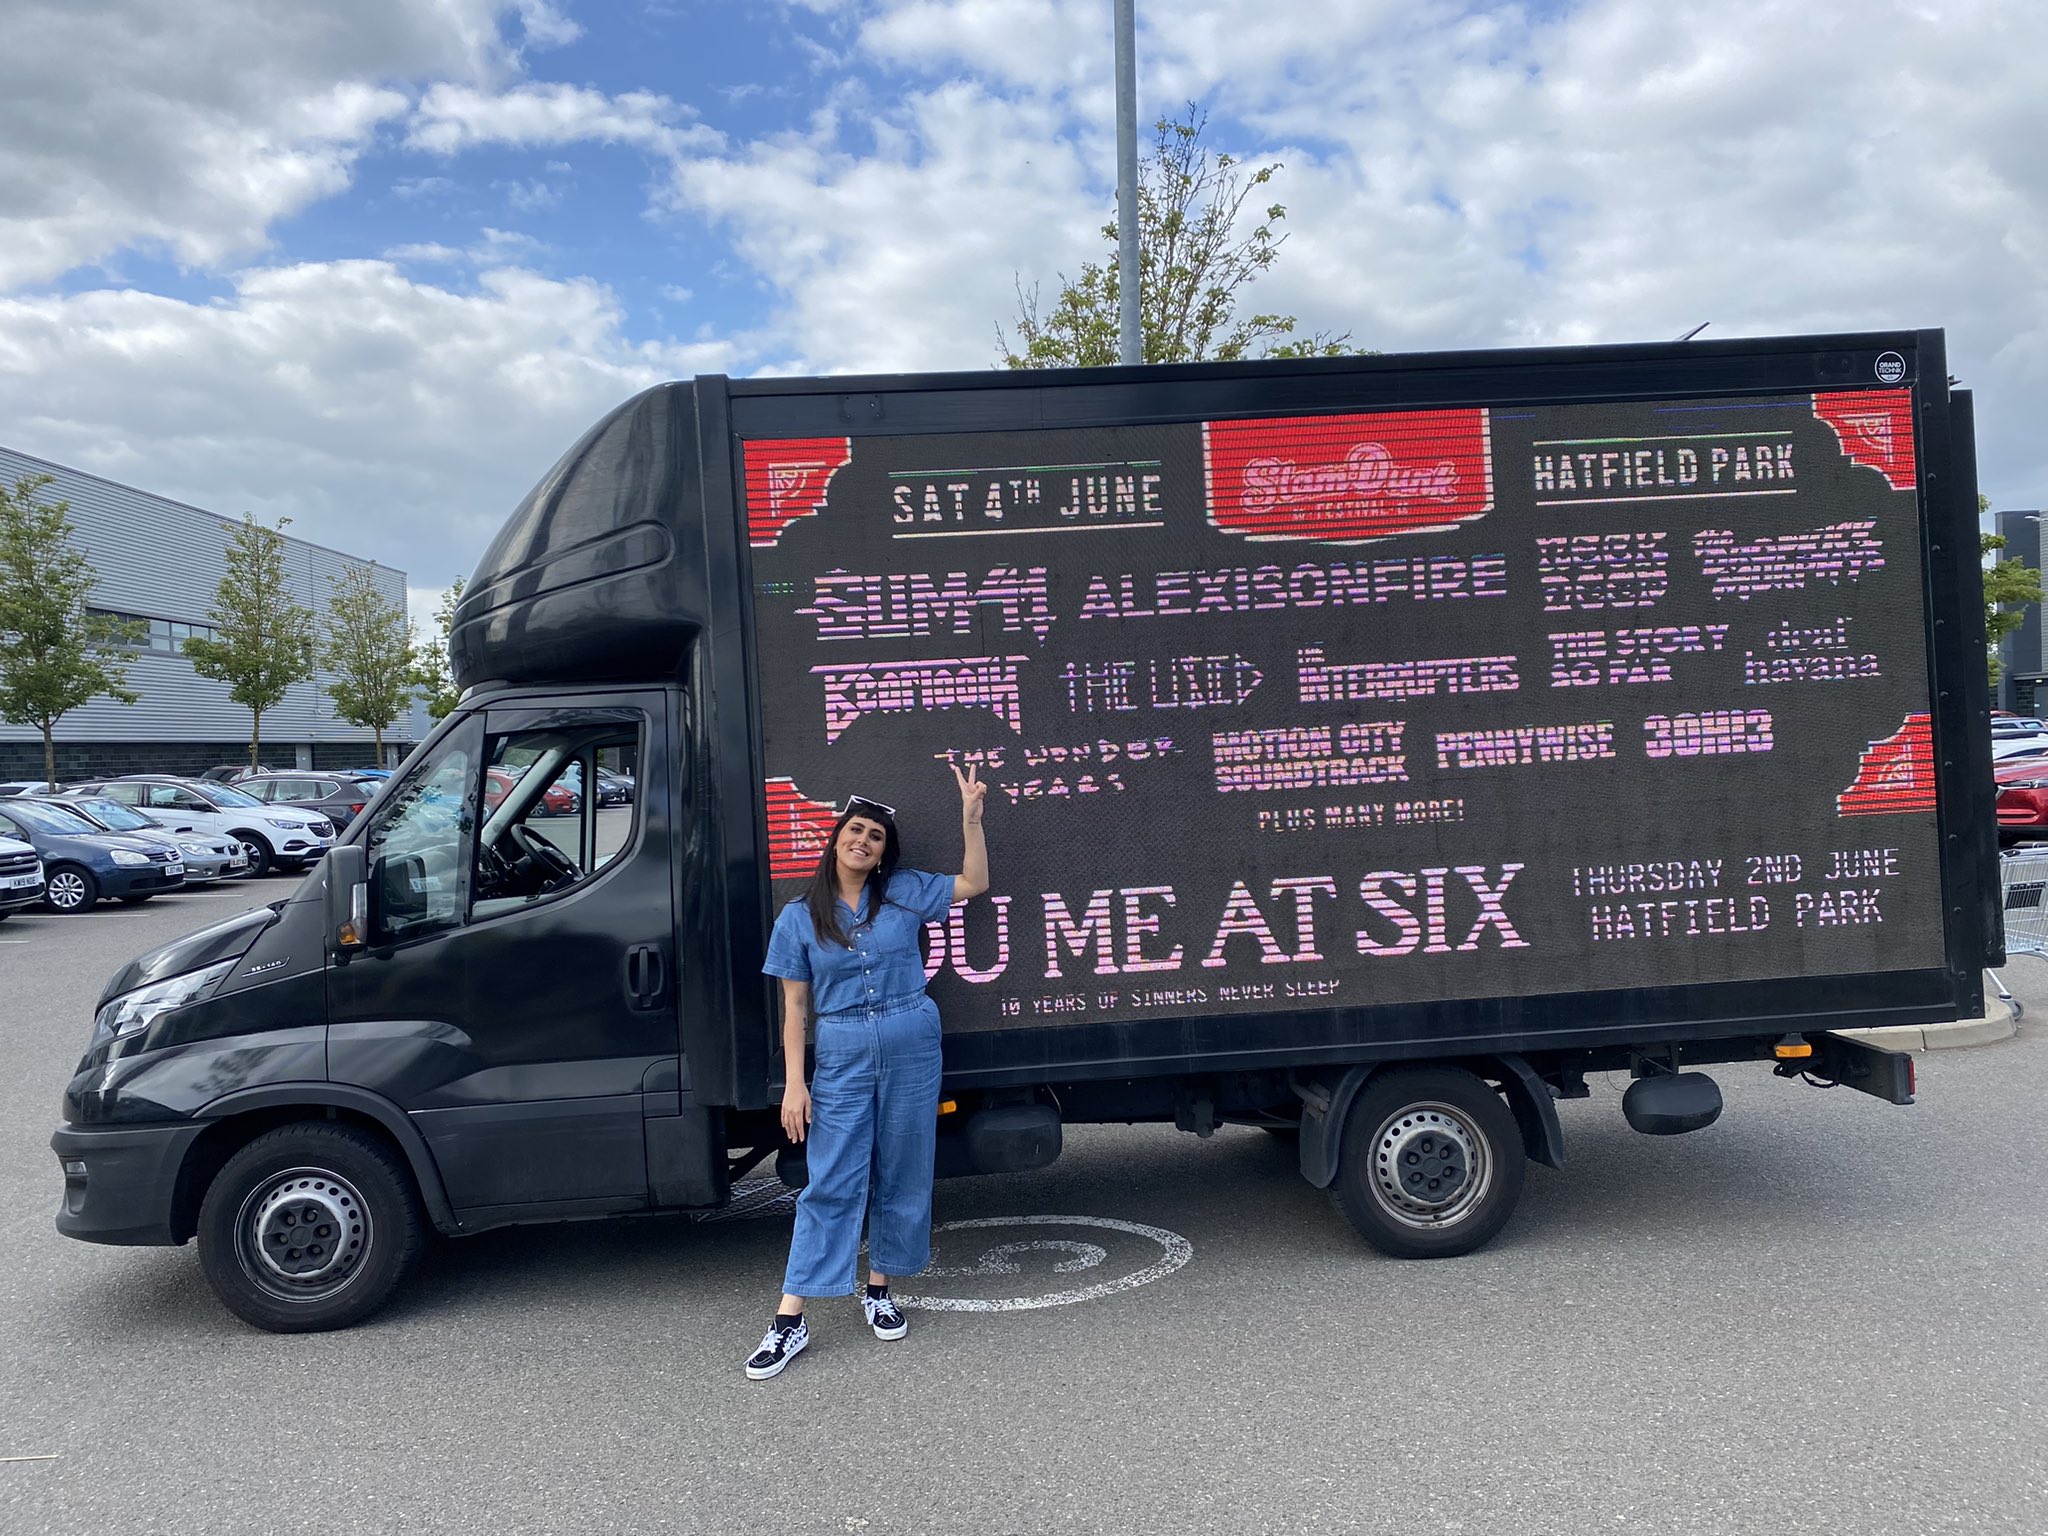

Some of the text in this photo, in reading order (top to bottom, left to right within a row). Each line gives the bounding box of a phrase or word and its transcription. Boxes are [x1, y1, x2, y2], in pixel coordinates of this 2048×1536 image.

[1533, 443, 1795, 492] HATFIELD PARK
[892, 483, 970, 523] SAT
[1060, 475, 1163, 520] JUNE
[1079, 553, 1508, 620] ALEXISONFIRE
[1615, 624, 1730, 656] STORY
[1210, 722, 1334, 764] MOTION
[1434, 719, 1617, 769] PENNYWISE
[1213, 752, 1412, 794] SOUNDTRACK
[1258, 807, 1316, 833] PLUS
[1573, 847, 1900, 896] THURSDAY 2ND JUNE
[1040, 885, 1184, 979] ME
[1200, 875, 1338, 968] AT
[1355, 862, 1532, 957] SIX
[1590, 888, 1883, 941] HATFIELD PARK
[1033, 992, 1087, 1014] YEARS
[1131, 988, 1208, 1007] SINNERS
[1219, 983, 1275, 1001] NEVER
[1285, 979, 1340, 997] SLEEP
